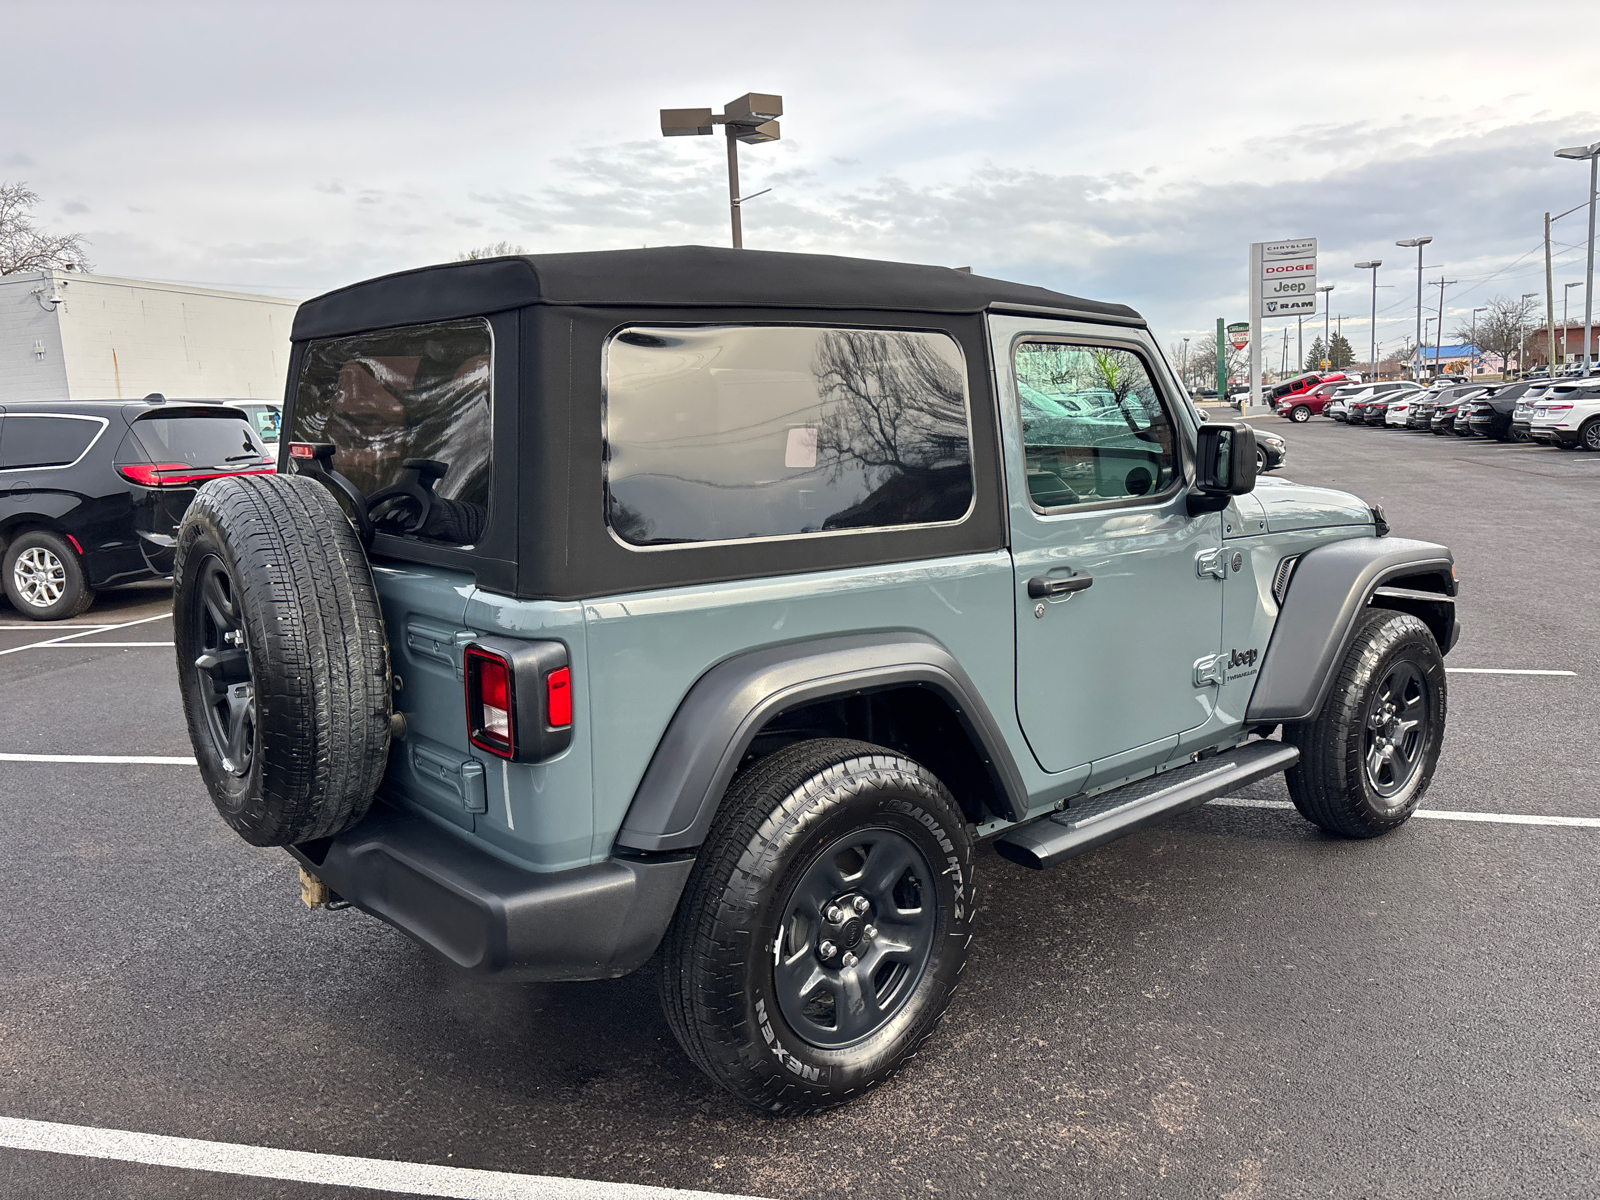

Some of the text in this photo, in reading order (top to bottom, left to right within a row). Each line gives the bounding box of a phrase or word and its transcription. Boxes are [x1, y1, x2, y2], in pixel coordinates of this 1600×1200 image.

[1267, 243, 1313, 251] CHRYSLER
[1266, 264, 1314, 273] DODGE
[1273, 282, 1306, 293] Jeep
[1280, 301, 1313, 309] RAM
[1227, 648, 1258, 669] Jeep
[1229, 669, 1257, 681] WRANGLER
[884, 799, 954, 854] ROADIAN
[755, 998, 820, 1082] NEXEN
